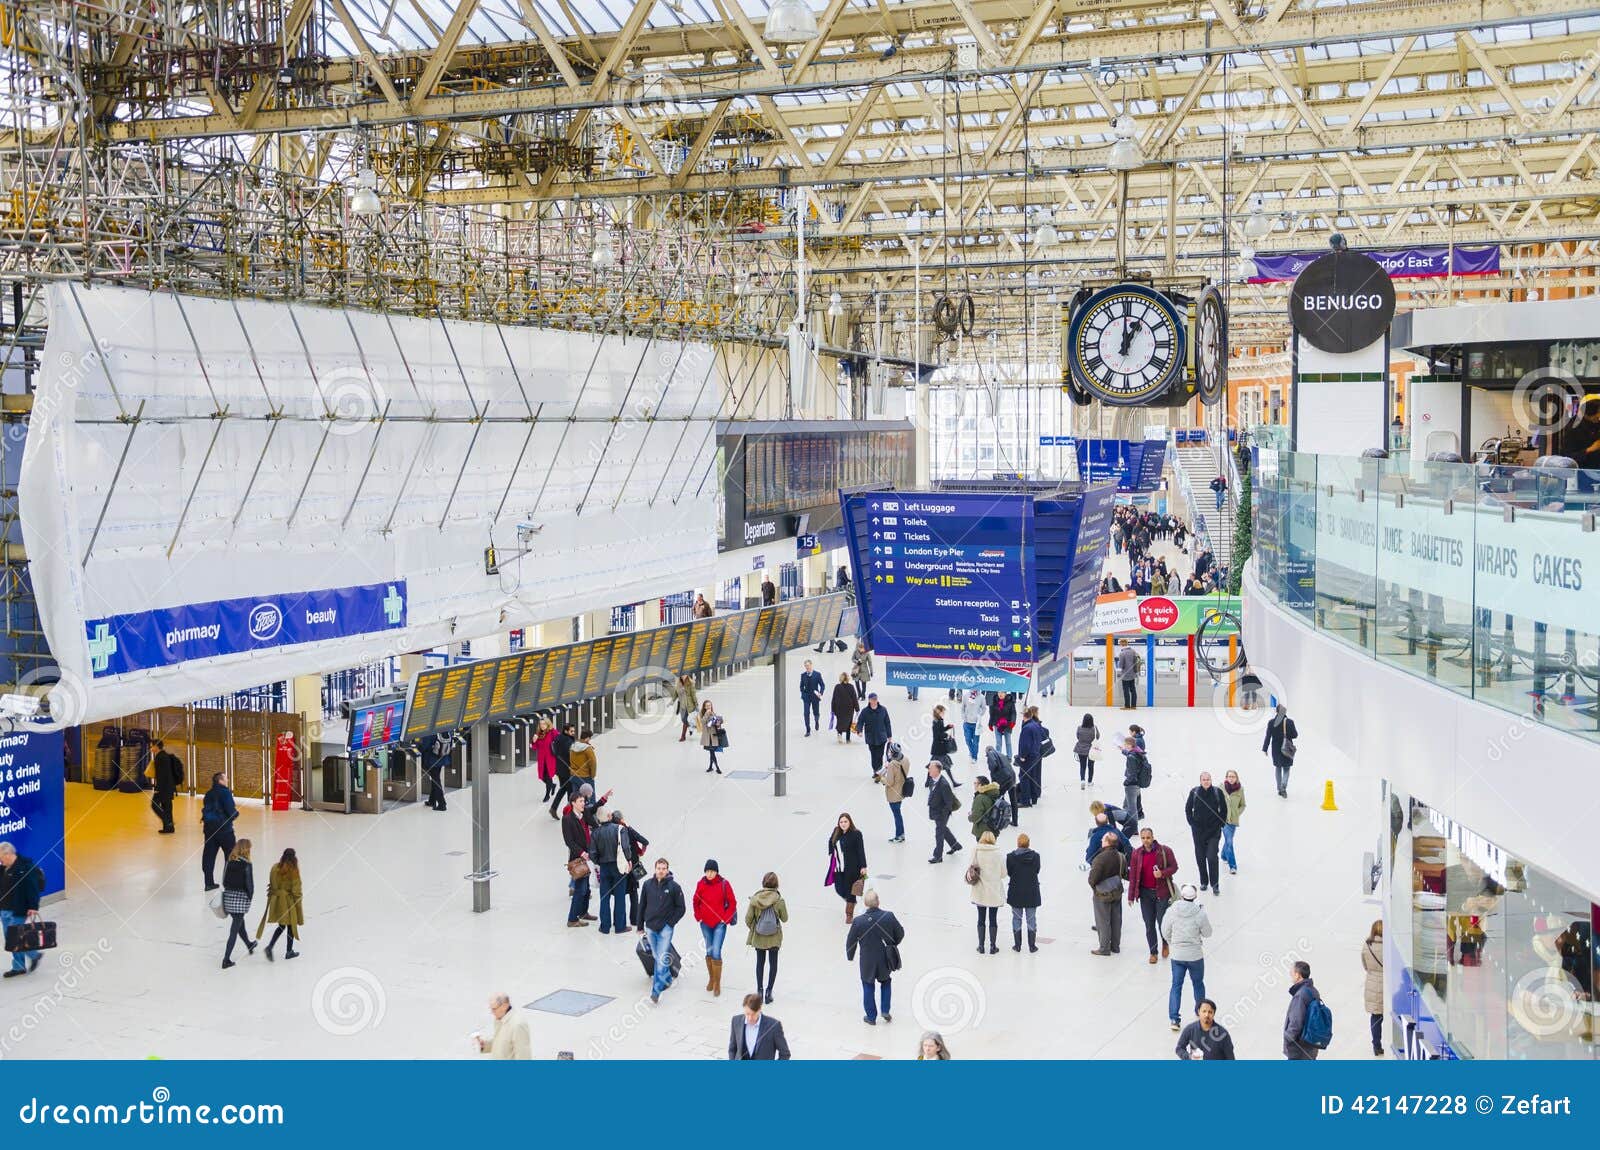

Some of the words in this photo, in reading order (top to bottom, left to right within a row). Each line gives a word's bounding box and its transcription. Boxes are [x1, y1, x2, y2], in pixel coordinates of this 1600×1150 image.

[1408, 257, 1433, 267] East
[1303, 294, 1382, 311] BENUGO
[904, 503, 919, 512] Left
[921, 504, 955, 514] Luggage
[903, 518, 927, 526] Toilets
[744, 522, 776, 542] Departures
[904, 533, 930, 541] Tickets
[803, 537, 813, 547] 15
[904, 548, 931, 556] London
[934, 548, 947, 558] Eye
[949, 548, 964, 557] Pier
[1382, 526, 1403, 554] JUICE
[1411, 532, 1463, 567] BAGUETTES
[1476, 542, 1518, 578] WRAPS
[1533, 553, 1582, 591] CAKES
[905, 562, 953, 572] Underground
[906, 576, 922, 586] Way
[936, 599, 962, 607] Station
[964, 600, 999, 608] reception
[306, 607, 336, 624] beauty
[1154, 607, 1174, 616] quick
[980, 614, 1000, 622] Taxis
[980, 629, 1000, 637] point
[968, 643, 985, 652] Way
[355, 673, 365, 686] 13
[893, 671, 927, 680] Welcome
[929, 673, 936, 681] to
[938, 673, 975, 683] Waterloo
[976, 675, 1006, 684] Station
[236, 695, 249, 710] 12
[6, 770, 14, 781] &
[16, 763, 40, 779] drink
[8, 786, 15, 798] &
[17, 779, 40, 796] child
